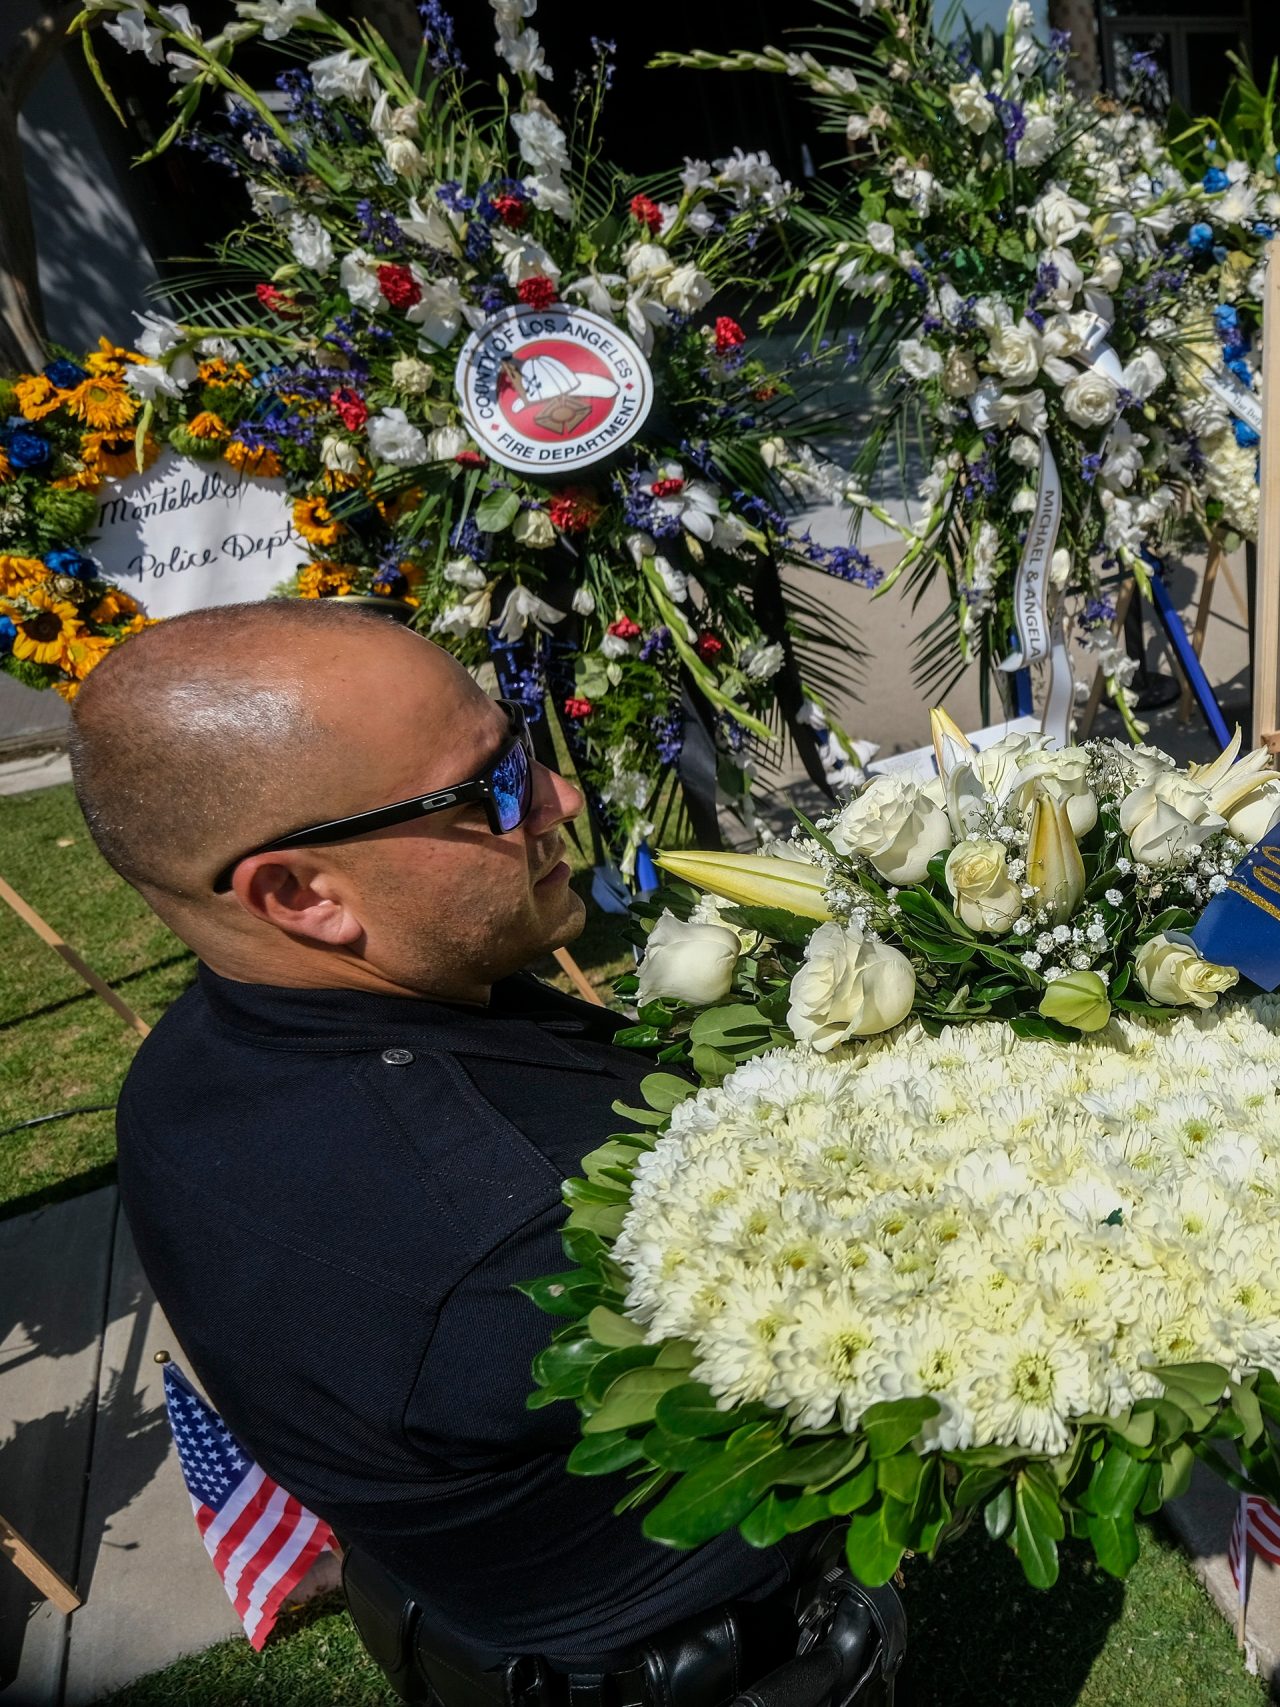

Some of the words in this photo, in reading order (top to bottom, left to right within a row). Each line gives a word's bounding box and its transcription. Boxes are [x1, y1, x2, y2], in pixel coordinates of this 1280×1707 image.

[474, 346, 498, 420] COUNTY
[492, 328, 515, 353] OF
[518, 318, 556, 338] LOS
[562, 322, 633, 379] ANGELES
[497, 432, 536, 461] FIRE
[538, 396, 636, 461] DEPARTMENT
[98, 471, 240, 528] Montebello
[1028, 489, 1055, 566] MICHAEL
[128, 546, 218, 582] Police
[1024, 569, 1040, 586] &
[1024, 588, 1042, 659] ANGELA
